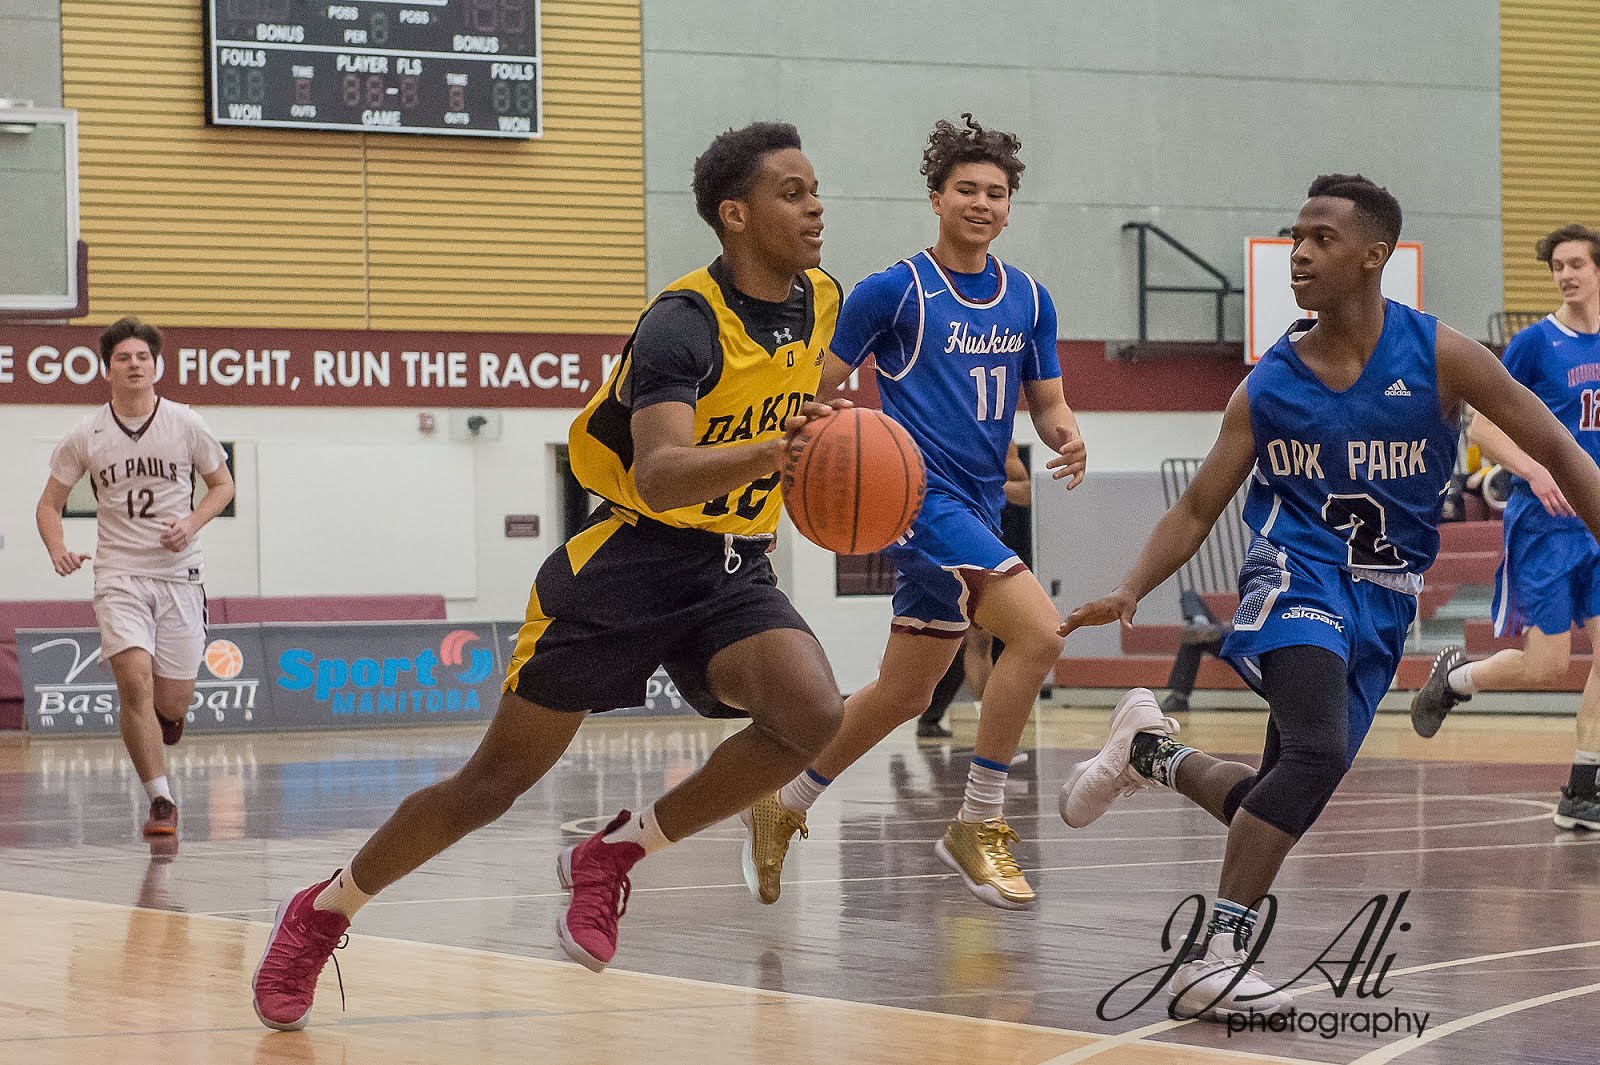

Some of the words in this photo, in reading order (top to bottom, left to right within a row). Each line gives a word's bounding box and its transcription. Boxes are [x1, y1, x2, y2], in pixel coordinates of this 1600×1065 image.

[256, 23, 305, 43] BONUS
[453, 34, 499, 53] BONUS
[221, 48, 266, 68] FOULS
[336, 54, 389, 74] PLAYER
[396, 57, 423, 75] FLS
[491, 63, 535, 81] FOULS
[228, 103, 262, 120] WON
[361, 109, 401, 126] GAME
[498, 116, 531, 132] WON
[944, 321, 1025, 354] Huskies
[27, 345, 164, 385] GO
[178, 347, 300, 391] FIGHT,
[314, 350, 390, 387] RUN
[401, 351, 468, 388] THE
[479, 352, 590, 393] RACE,
[969, 366, 1007, 421] 11
[1385, 388, 1411, 397] adidas
[1348, 438, 1428, 480] PARK
[99, 465, 118, 488] ST
[125, 458, 177, 482] PAULS
[127, 488, 157, 519] 12
[1321, 494, 1409, 570] 2
[1281, 605, 1345, 632] oakpark
[276, 648, 438, 700] Sport
[37, 685, 258, 715] Basall
[331, 688, 480, 715] MANITOBA
